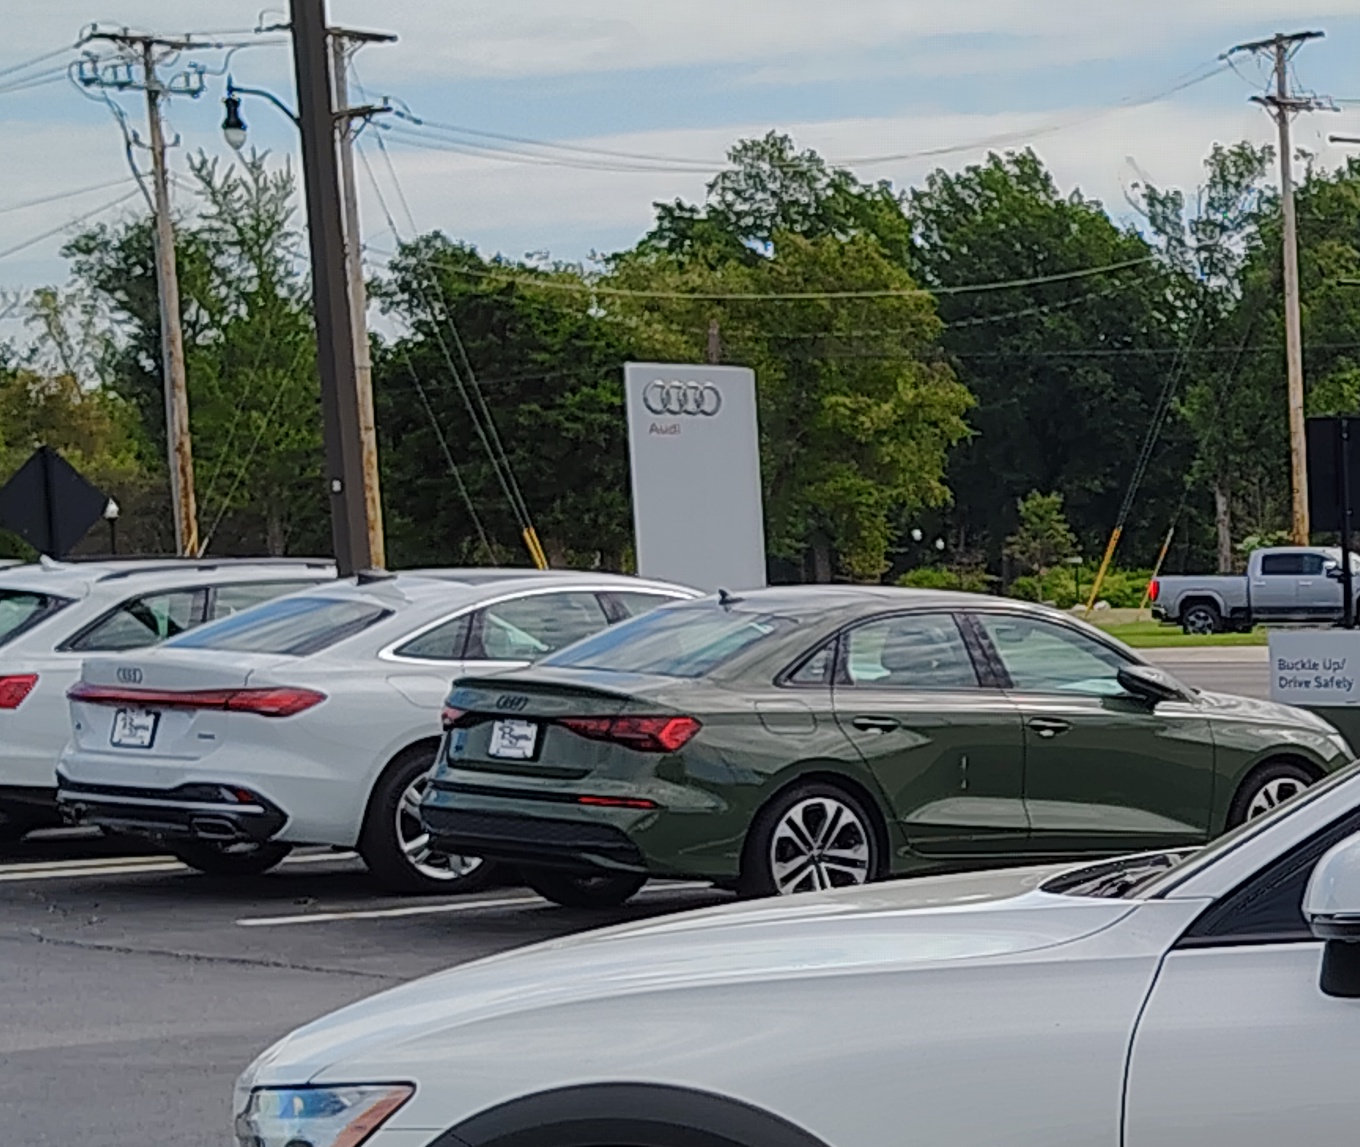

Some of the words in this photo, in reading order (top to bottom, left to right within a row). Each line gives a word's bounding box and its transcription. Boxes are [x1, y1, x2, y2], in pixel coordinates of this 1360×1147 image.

[649, 422, 681, 435] Audi
[1278, 658, 1319, 671] Buckle
[1279, 676, 1311, 689] Drive
